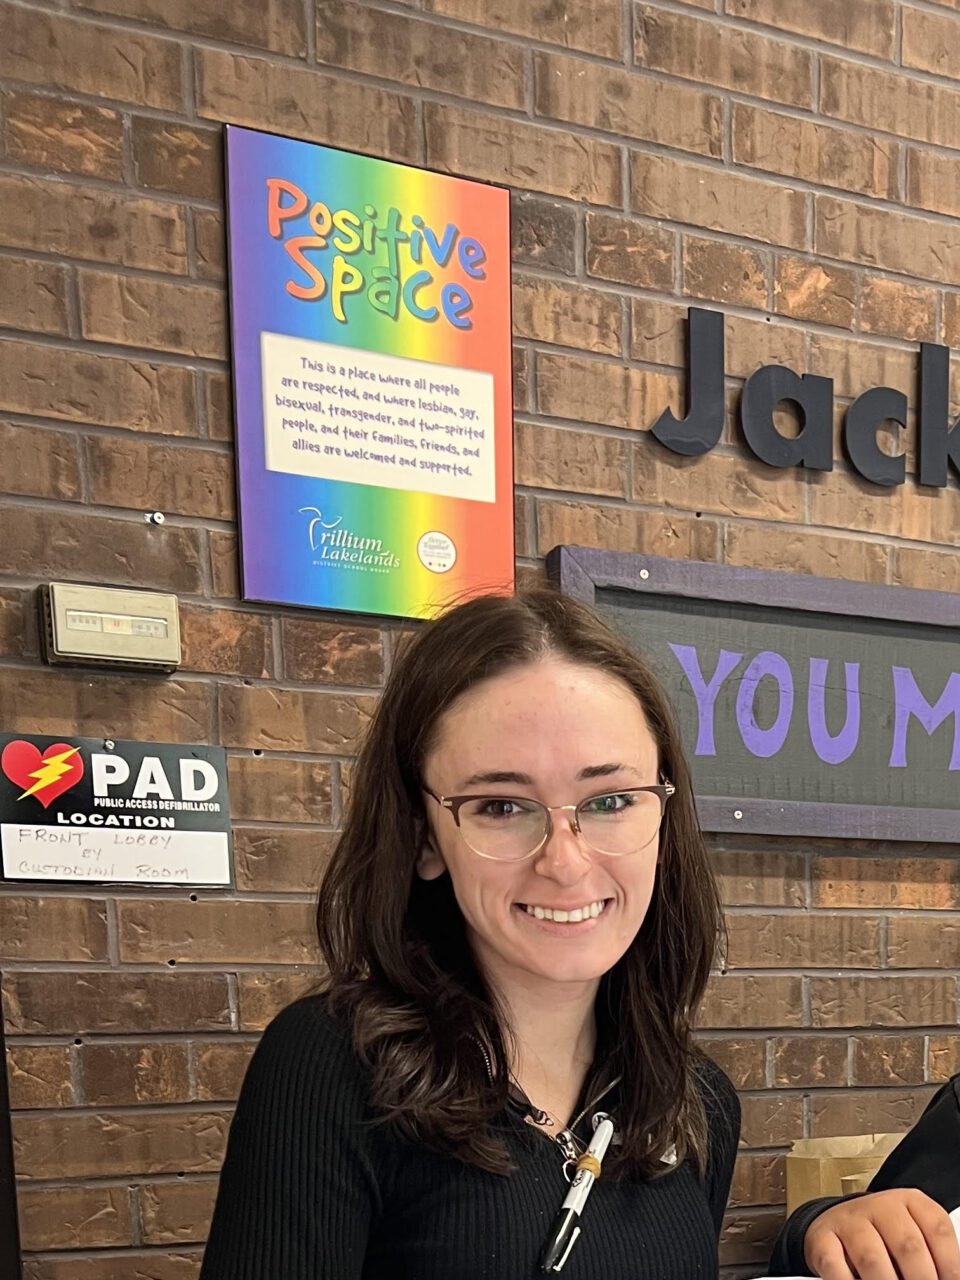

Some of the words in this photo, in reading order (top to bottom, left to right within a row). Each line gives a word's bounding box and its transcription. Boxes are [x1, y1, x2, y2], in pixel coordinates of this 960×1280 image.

[266, 178, 486, 280] Positive
[284, 236, 472, 330] Space
[301, 357, 324, 372] This
[326, 363, 336, 374] is
[339, 366, 345, 376] a
[349, 367, 376, 381] place
[379, 374, 411, 387] where
[414, 379, 427, 390] all
[429, 383, 460, 396] people
[275, 394, 325, 414] bisexual,
[328, 404, 396, 426] transgender,
[398, 416, 416, 427] and
[419, 419, 485, 440] two-spirited
[281, 377, 299, 388] are
[302, 381, 360, 400] respected,
[363, 391, 380, 401] and
[384, 394, 415, 408] where
[418, 398, 457, 416] lesbian,
[460, 406, 479, 420] gay,
[282, 417, 318, 433] people,
[321, 423, 339, 435] and
[342, 425, 368, 440] their
[372, 431, 418, 449] families,
[420, 438, 460, 455] friends,
[463, 446, 480, 458] and
[292, 438, 320, 453] allies
[324, 443, 341, 455] are
[344, 446, 396, 464] welcomed
[399, 456, 417, 468] and
[419, 459, 473, 477] supported.
[321, 547, 401, 569] Lakelands
[667, 642, 862, 766] YOU
[91, 753, 219, 801] PAD
[57, 812, 175, 828] LOCATION
[94, 797, 124, 808] PUBLIC
[125, 799, 158, 810] ACCESS
[159, 801, 221, 812] DEFIBRILLATOR
[18, 828, 89, 846] FRONT
[114, 834, 172, 849] LOBBY
